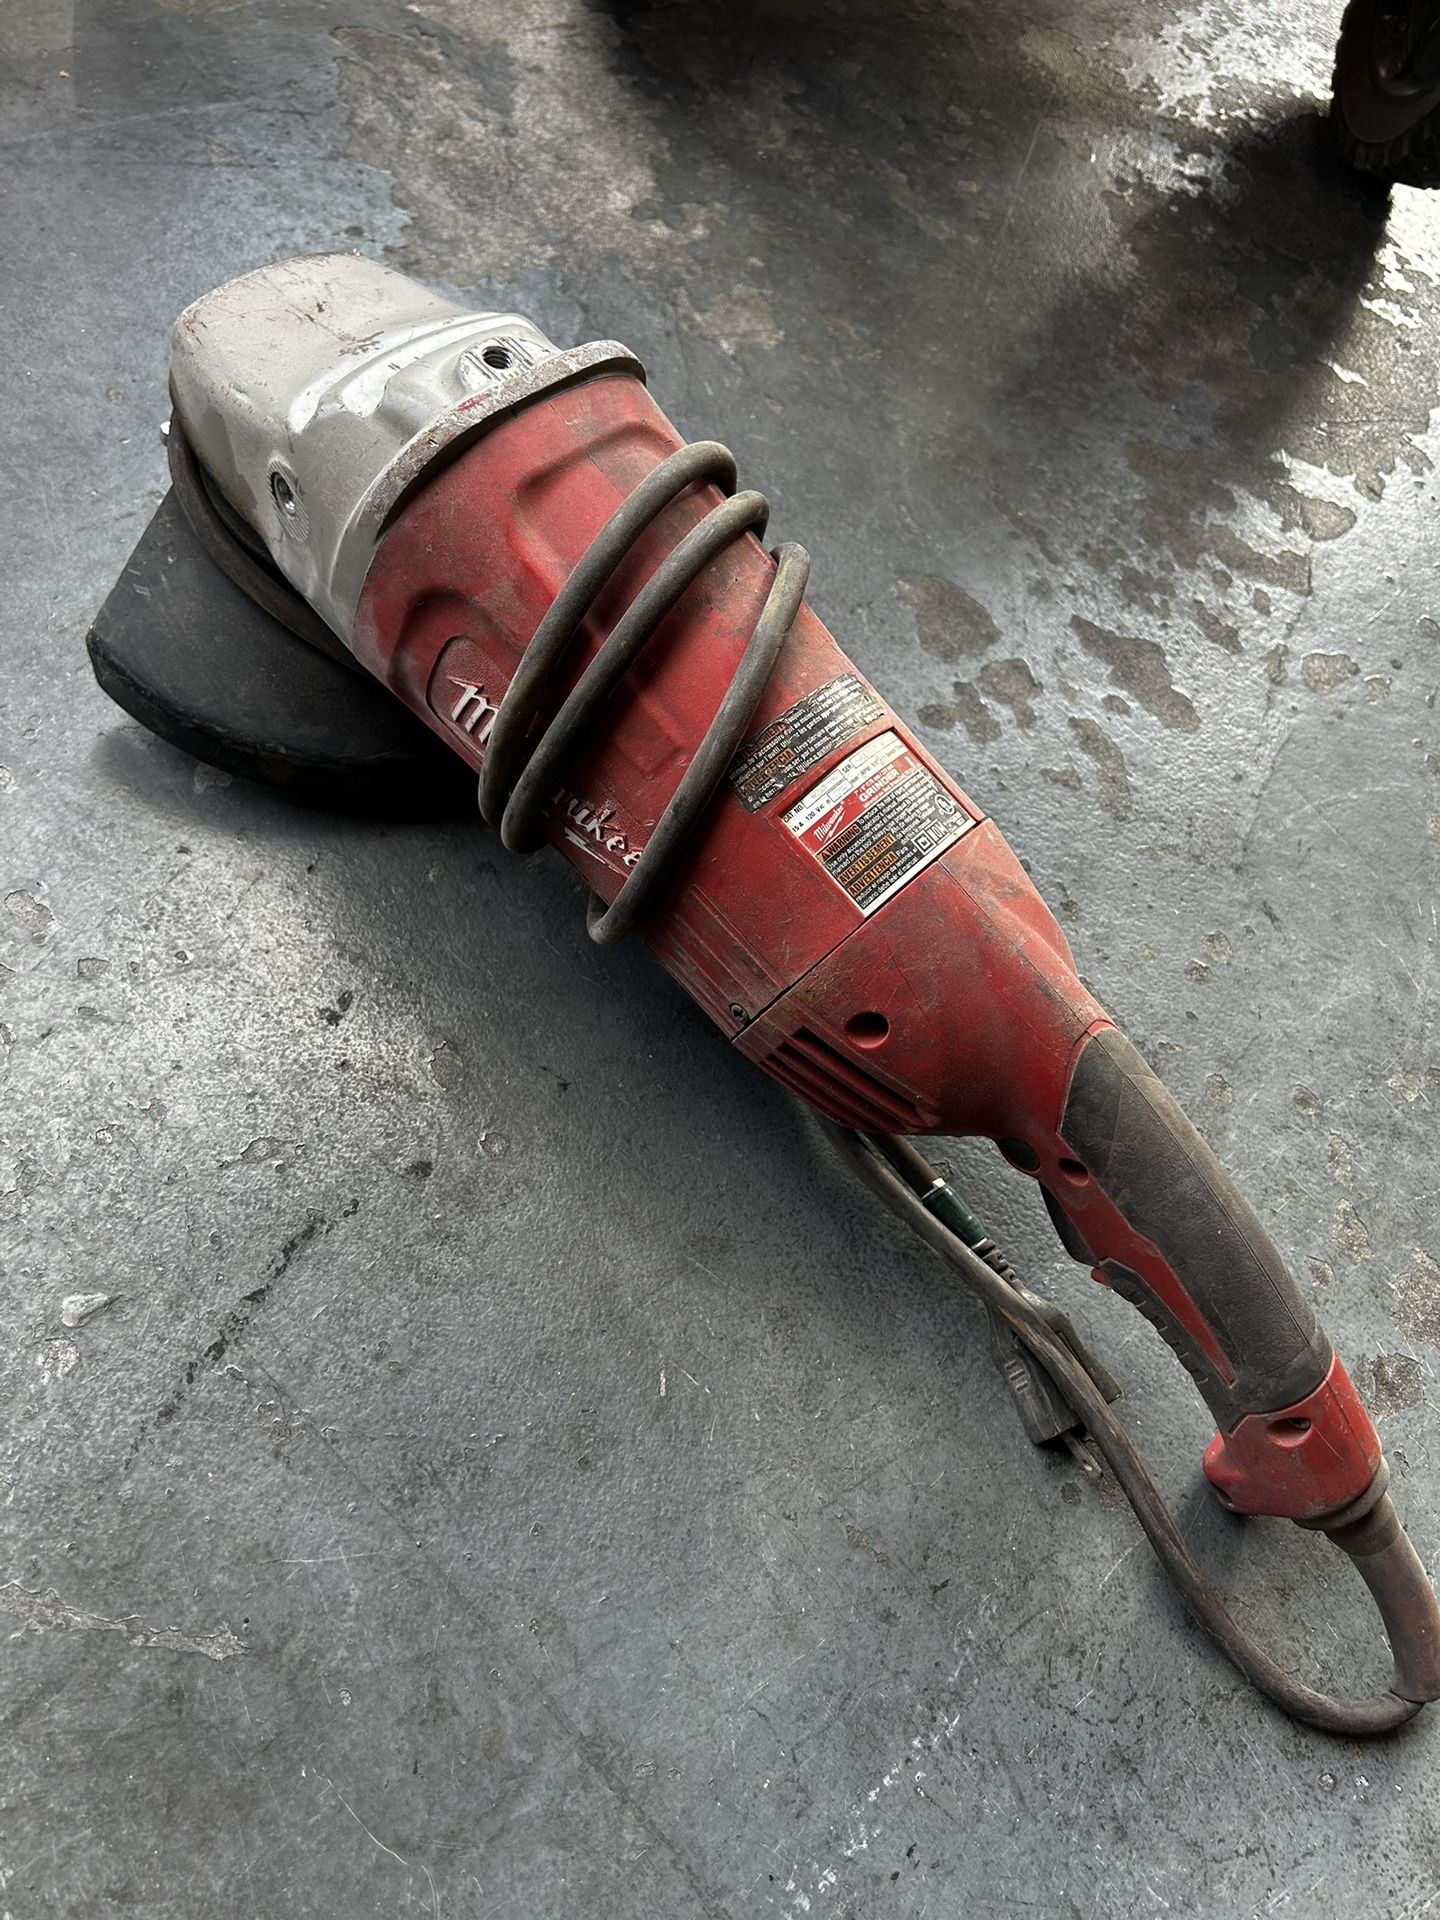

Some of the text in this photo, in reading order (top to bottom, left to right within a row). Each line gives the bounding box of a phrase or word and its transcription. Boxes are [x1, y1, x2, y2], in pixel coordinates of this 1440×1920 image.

[857, 767, 899, 803] GRINDER
[805, 810, 815, 821] 120
[814, 804, 844, 841] Milwaukee
[826, 824, 860, 855] WARNING
[826, 858, 838, 870] Use
[836, 850, 848, 862] only
[831, 857, 850, 876] marked
[854, 845, 864, 856] the
[838, 834, 894, 884] AVERTISSEMENT
[848, 844, 908, 896] ADVERTENCIA Para
[875, 869, 891, 884] riesgo
[894, 850, 913, 867] lesiones
[860, 890, 879, 908] usuario
[876, 879, 890, 894] debe
